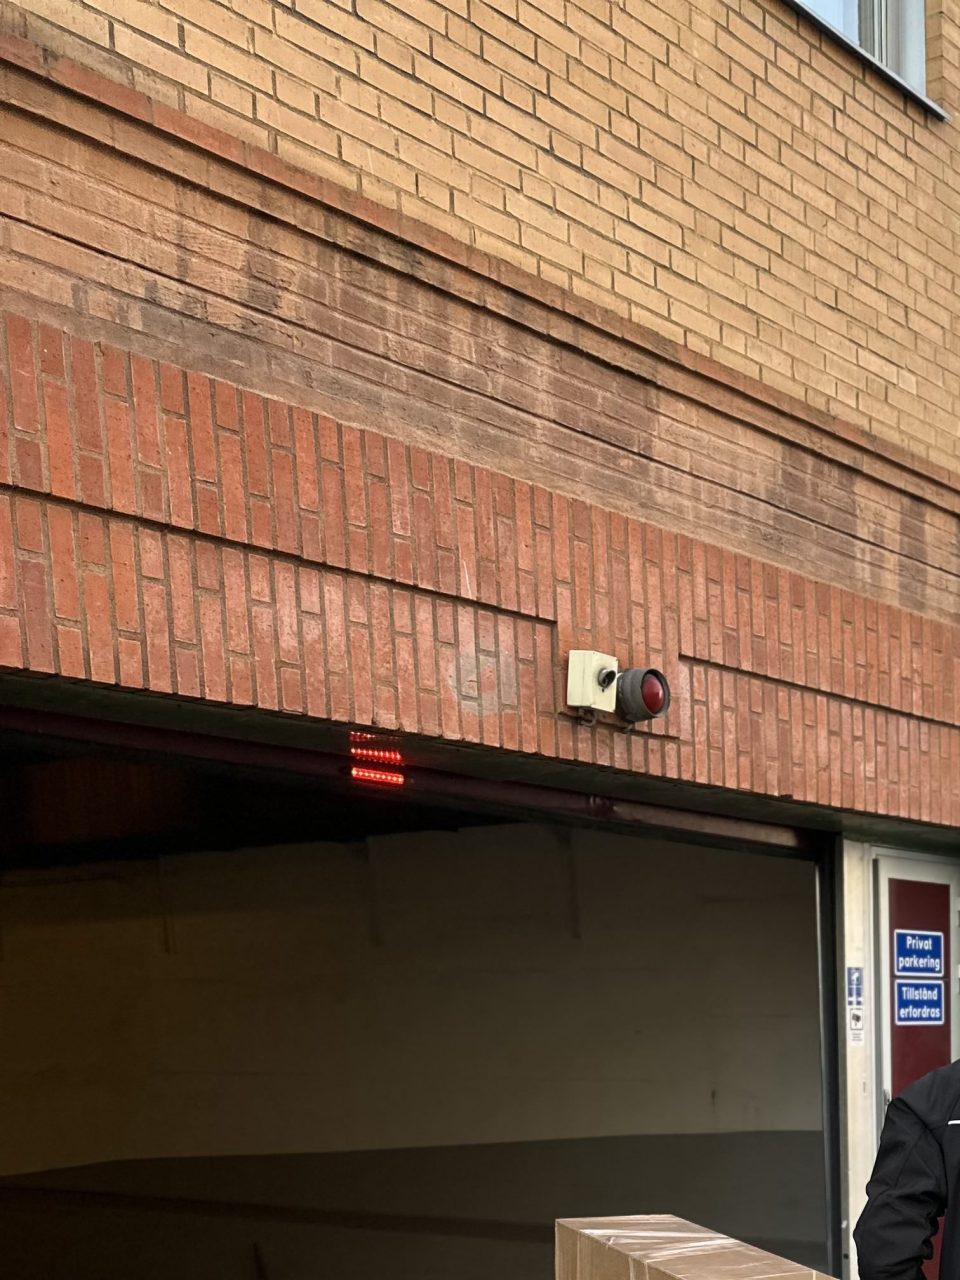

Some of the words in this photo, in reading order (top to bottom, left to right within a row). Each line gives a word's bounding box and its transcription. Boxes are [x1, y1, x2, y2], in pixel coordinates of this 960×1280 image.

[906, 936, 932, 950] Privat
[898, 955, 940, 971] parkering
[902, 986, 937, 1000] Tillstånd
[899, 1005, 940, 1018] erfordras
